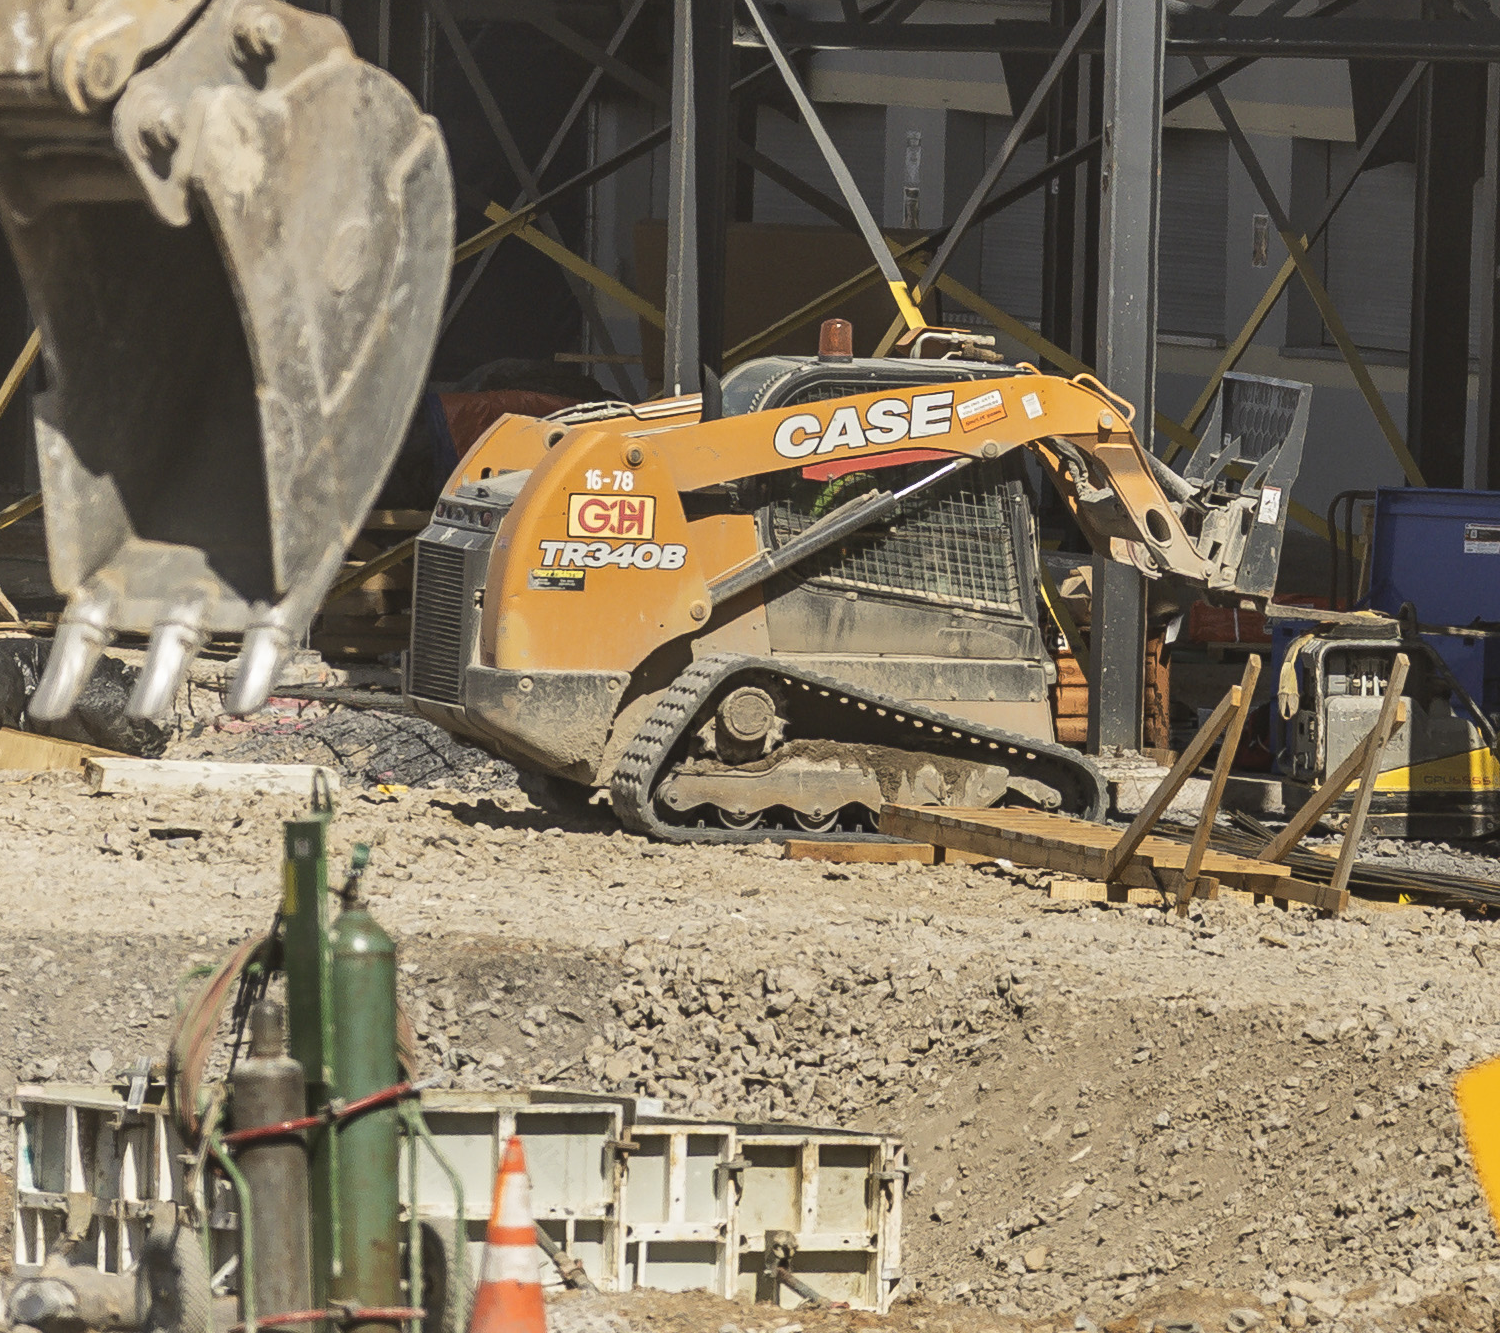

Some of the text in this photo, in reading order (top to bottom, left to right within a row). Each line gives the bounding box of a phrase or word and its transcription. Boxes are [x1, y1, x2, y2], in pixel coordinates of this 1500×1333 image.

[774, 390, 954, 459] CASE
[585, 469, 634, 492] 16-78
[539, 540, 688, 570] TR340B
